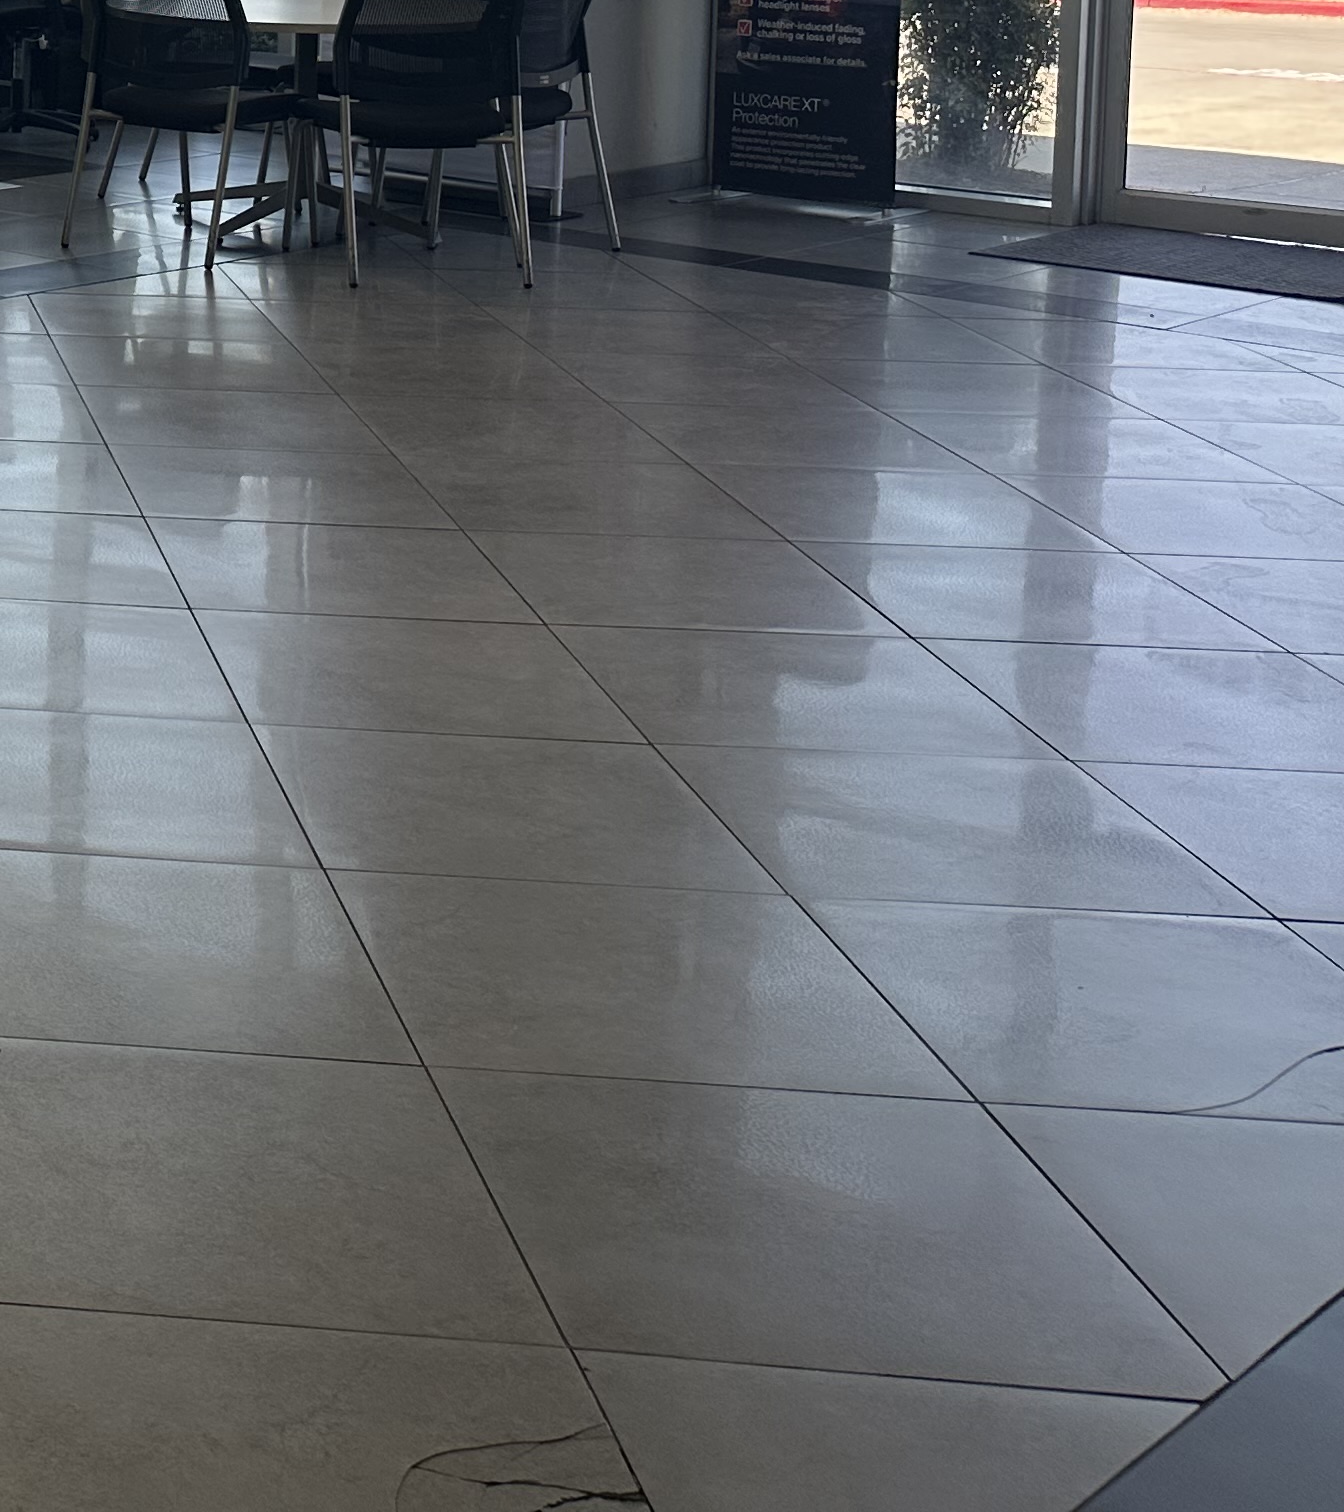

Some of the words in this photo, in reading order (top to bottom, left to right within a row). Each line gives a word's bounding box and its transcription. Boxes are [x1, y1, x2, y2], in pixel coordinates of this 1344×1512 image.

[758, 0, 799, 12] headlight
[801, 2, 831, 13] lenses
[757, 18, 834, 32] Weather-induced
[756, 29, 794, 42] chalking
[794, 33, 805, 41] or
[806, 32, 825, 42] loss
[825, 33, 836, 43] of
[837, 35, 862, 46] gloss
[732, 108, 799, 128] Protection
